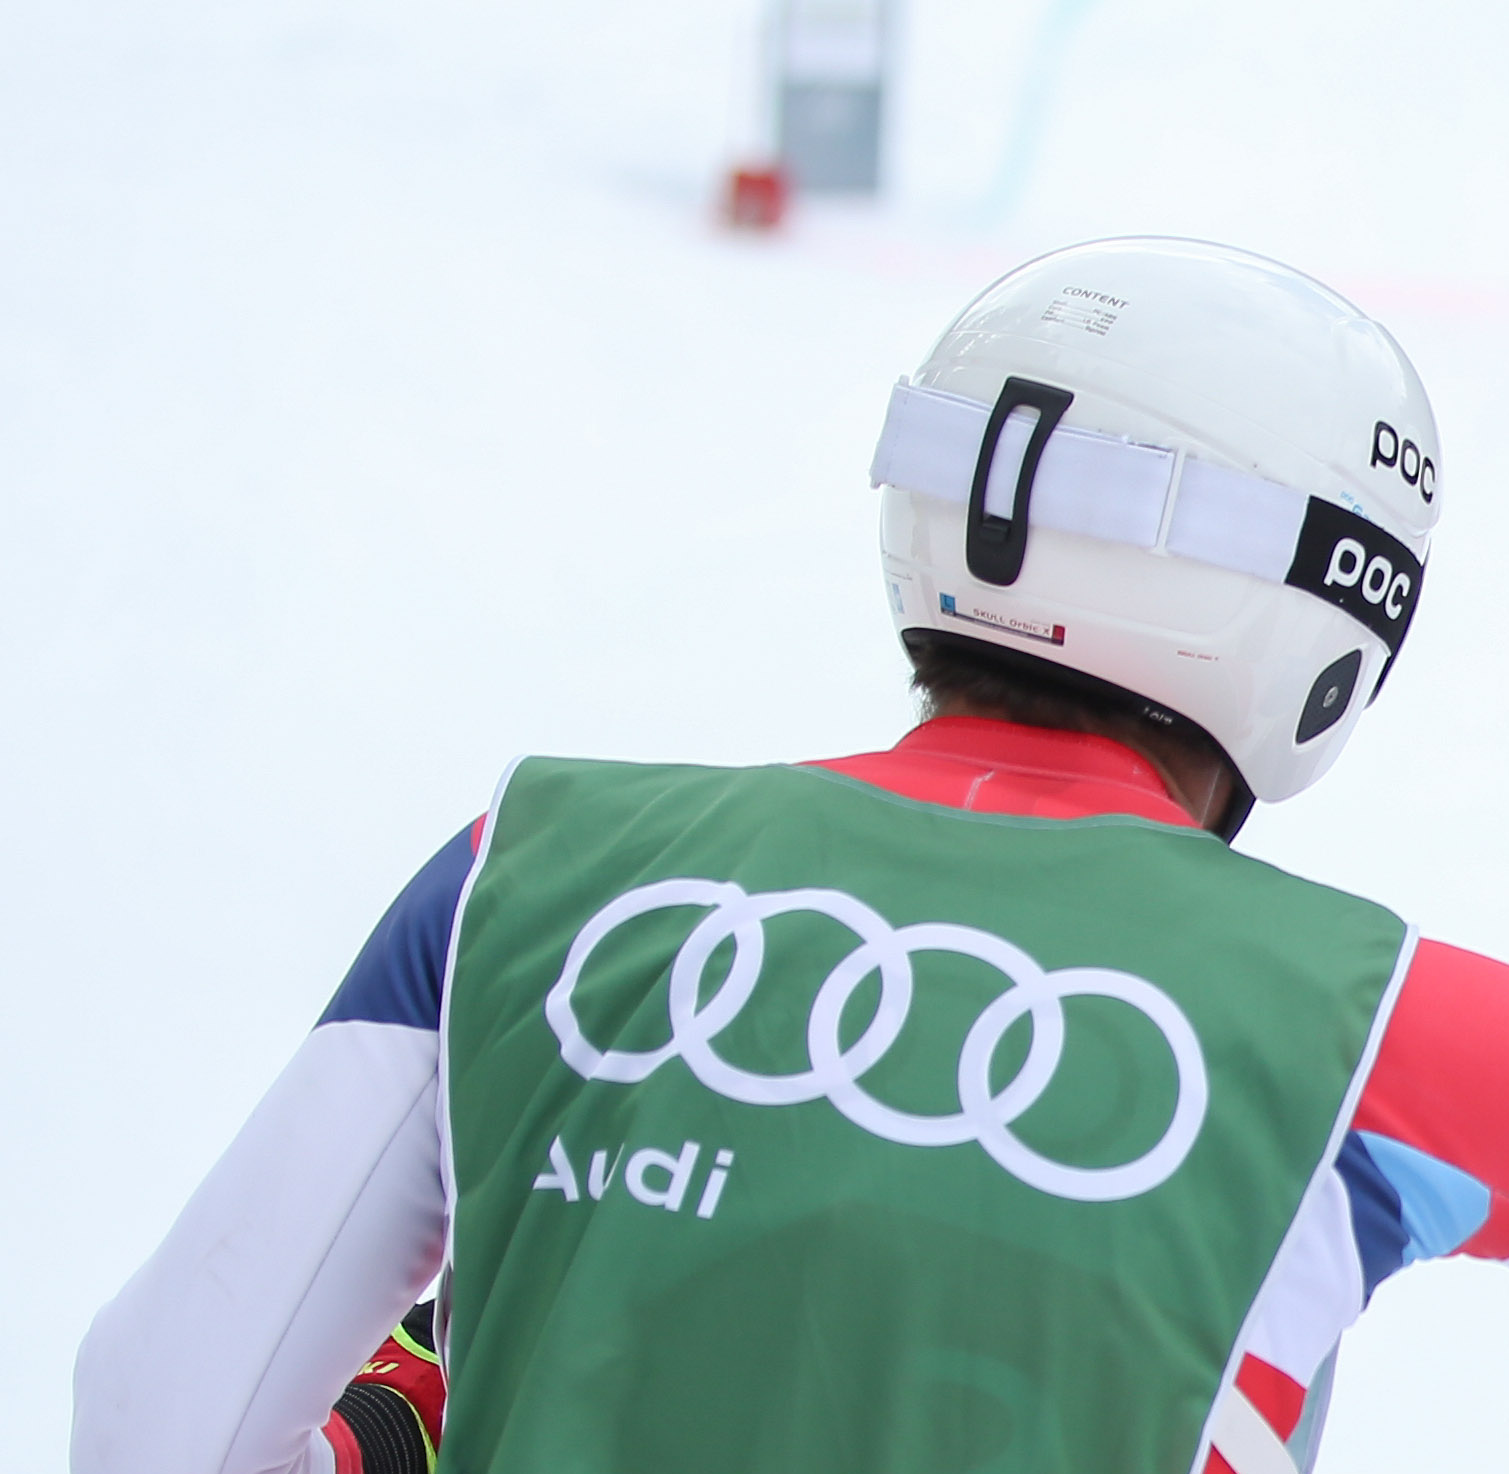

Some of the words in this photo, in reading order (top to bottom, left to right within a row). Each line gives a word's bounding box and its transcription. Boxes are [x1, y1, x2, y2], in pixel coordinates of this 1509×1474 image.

[1062, 286, 1129, 309] CONTENT
[973, 608, 1006, 626] SKULL
[533, 1134, 735, 1220] Audi
[357, 1360, 400, 1376] KI
